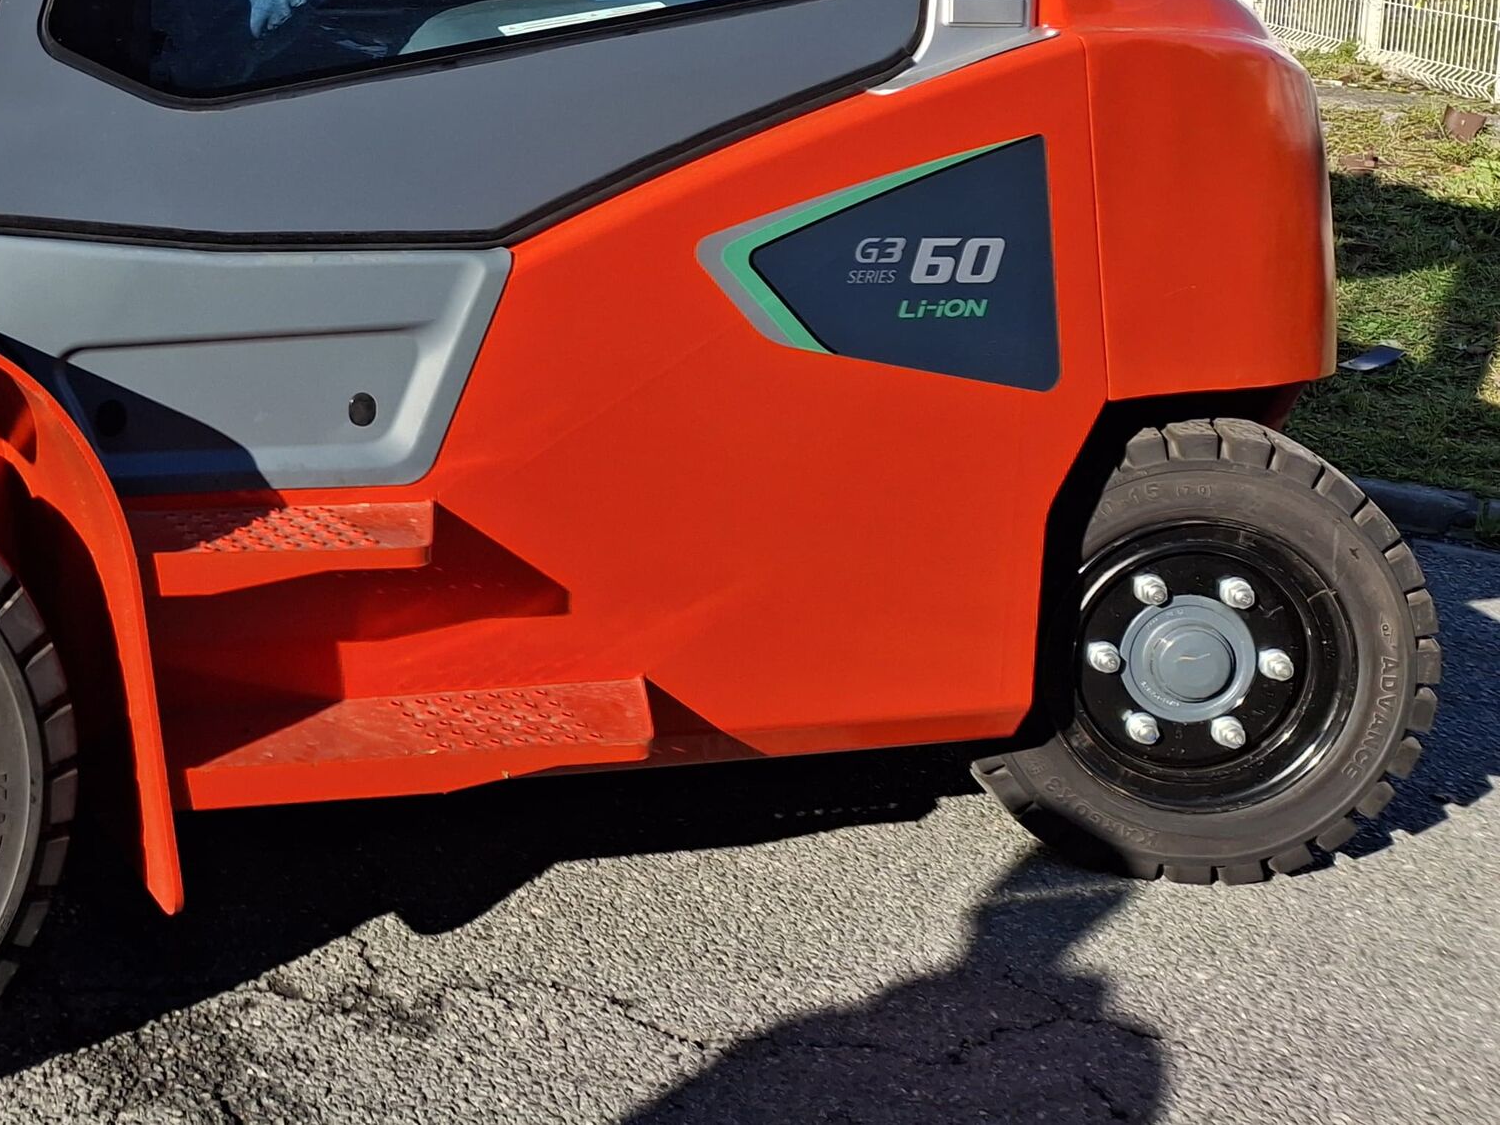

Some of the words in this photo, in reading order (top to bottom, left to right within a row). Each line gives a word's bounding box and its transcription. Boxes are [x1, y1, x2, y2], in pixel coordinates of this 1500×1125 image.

[854, 237, 908, 264] G3
[910, 237, 1006, 285] 60
[846, 270, 897, 284] SERIES
[1341, 656, 1399, 779] ADVANCE
